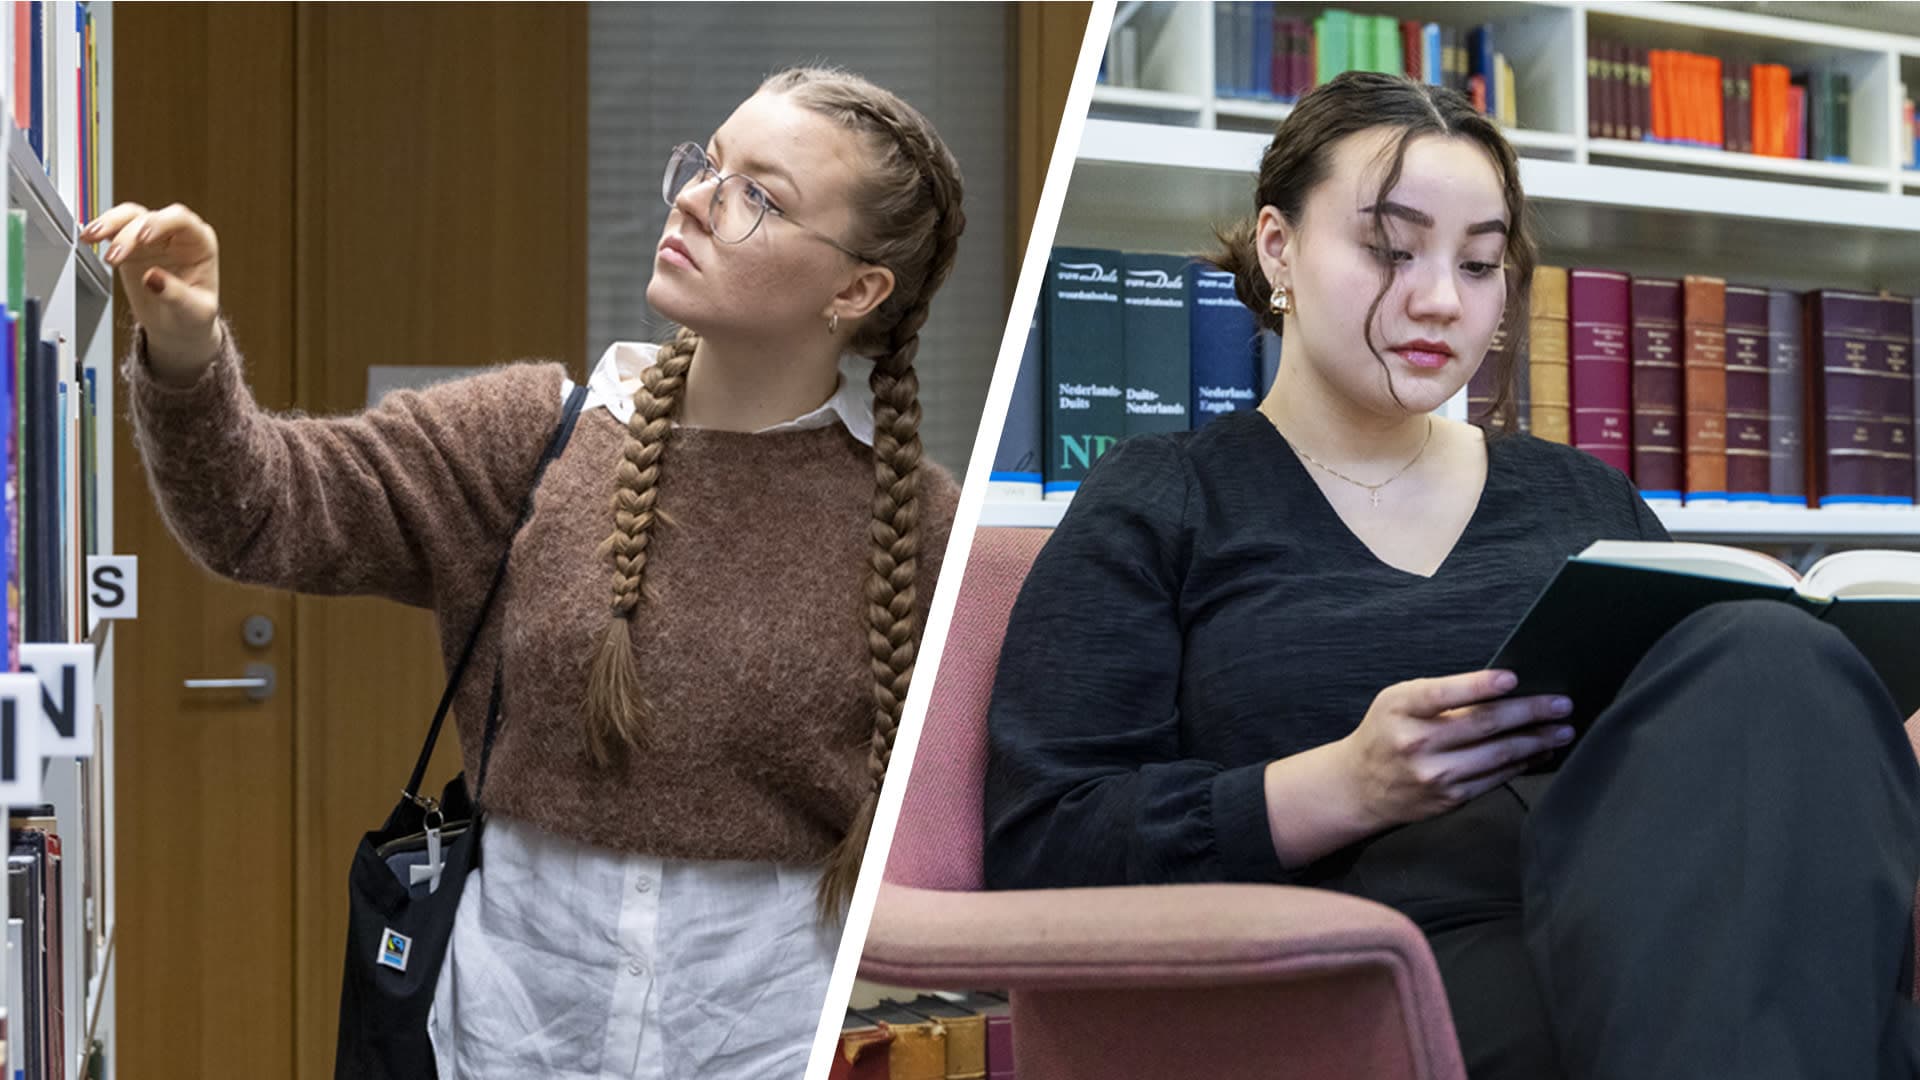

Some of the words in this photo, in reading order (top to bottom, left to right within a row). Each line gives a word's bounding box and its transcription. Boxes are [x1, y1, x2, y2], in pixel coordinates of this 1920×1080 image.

[1059, 397, 1090, 409] Duits
[1125, 402, 1185, 414] Nederlands
[1199, 400, 1235, 414] Engels
[91, 565, 125, 608] S
